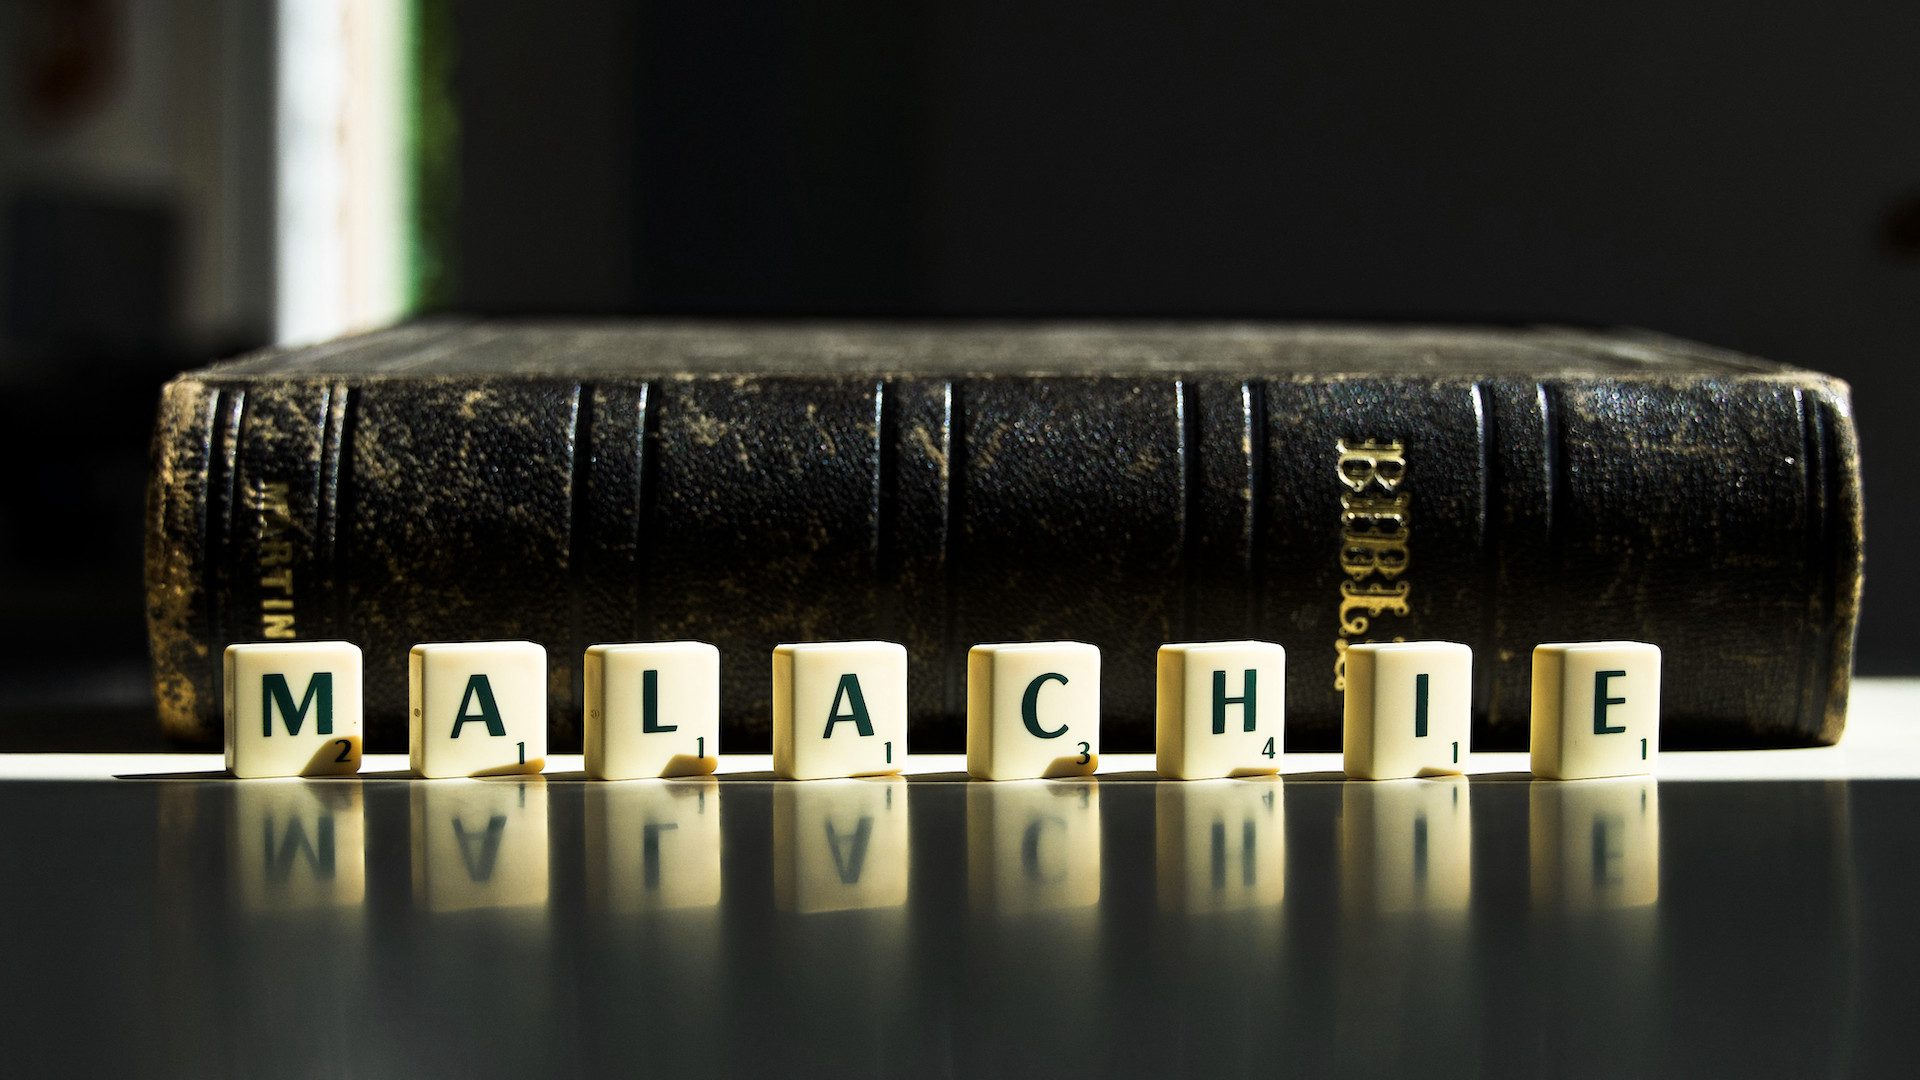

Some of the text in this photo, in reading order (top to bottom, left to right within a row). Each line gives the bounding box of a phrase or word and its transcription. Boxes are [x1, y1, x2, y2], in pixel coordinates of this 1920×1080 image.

[1334, 438, 1410, 691] BIBL
[335, 736, 1647, 766] 2 1 1 1 3 4 1 1
